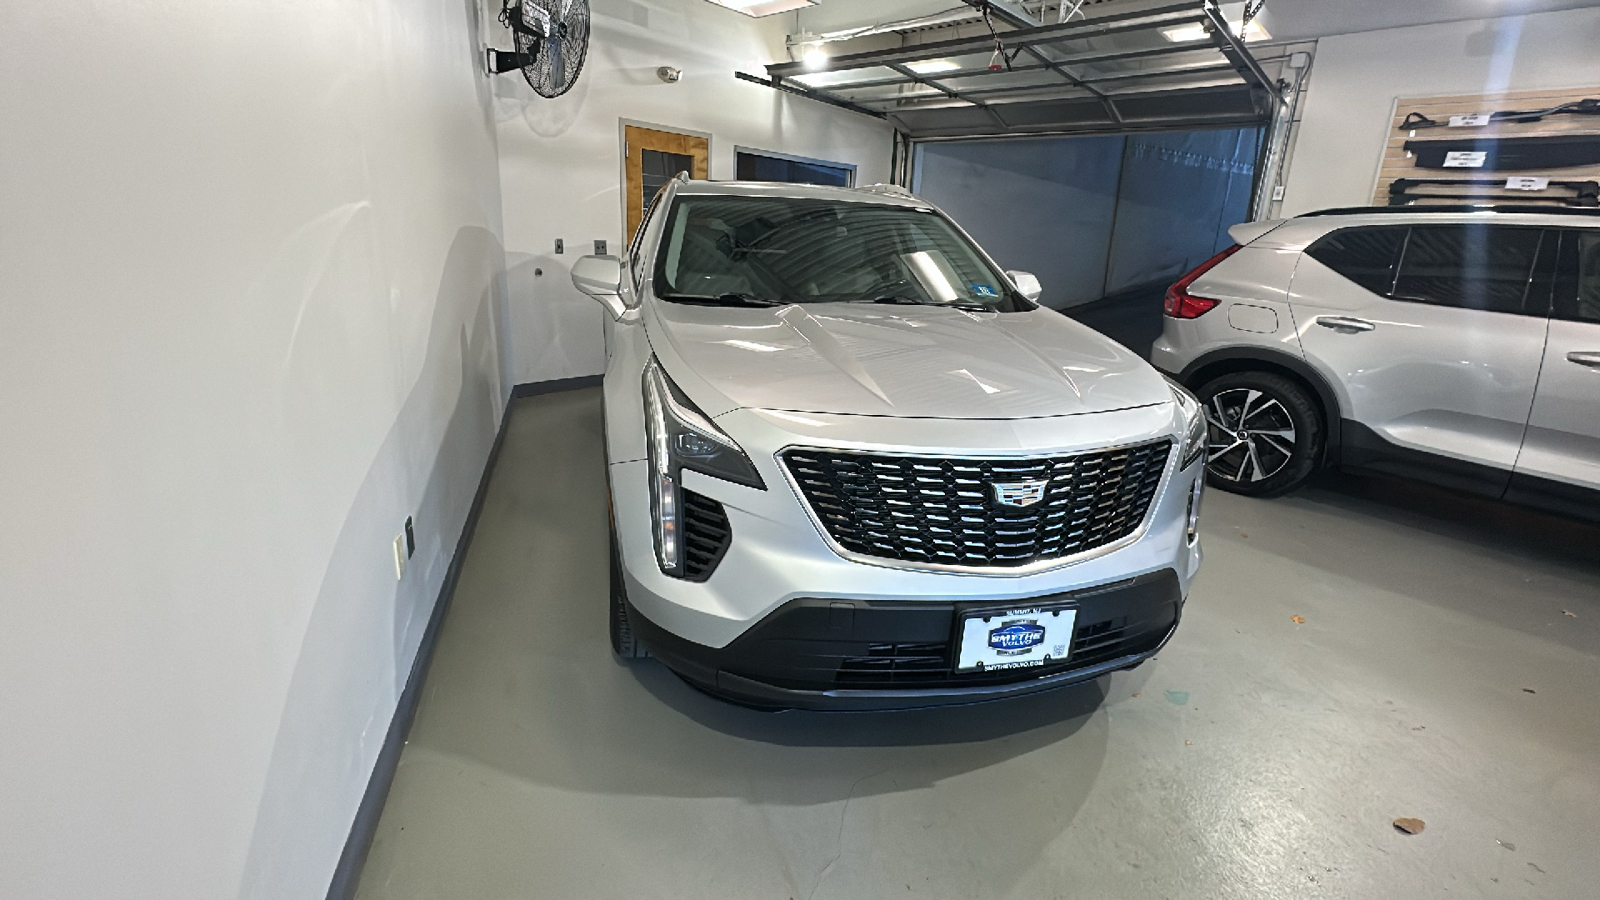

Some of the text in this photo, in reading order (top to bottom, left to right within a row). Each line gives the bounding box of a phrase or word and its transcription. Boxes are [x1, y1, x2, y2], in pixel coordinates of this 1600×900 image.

[991, 632, 1041, 643] SMYTHE
[1002, 639, 1032, 647] VOLVO
[984, 660, 1044, 671] SMYTHEVOLVO.COM
